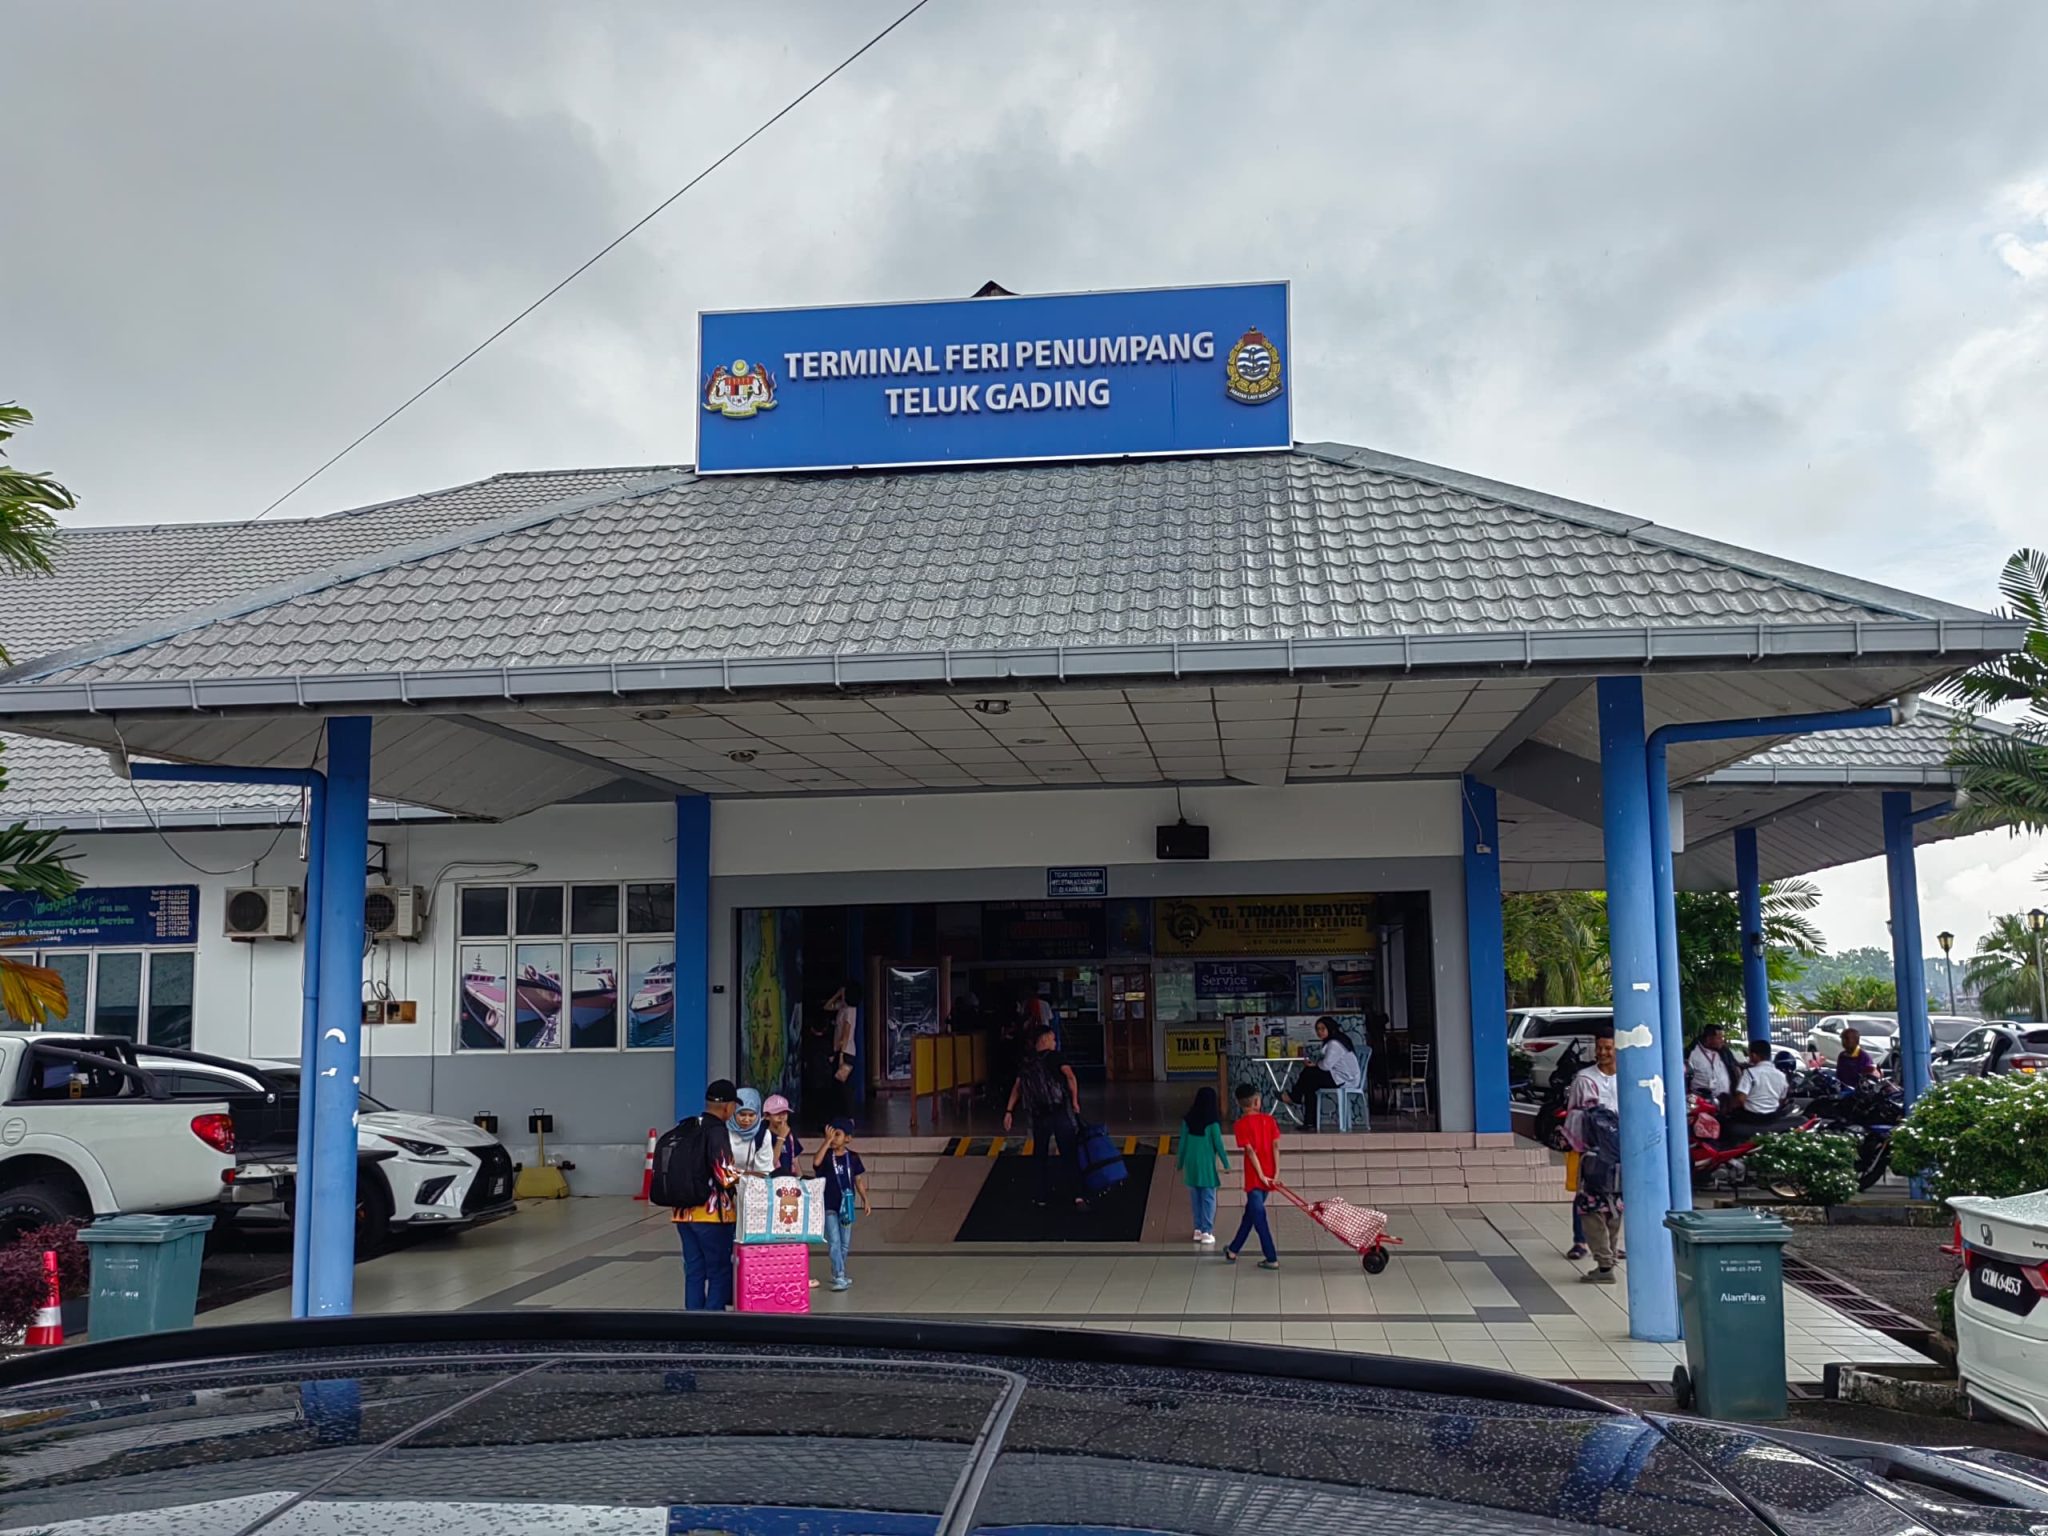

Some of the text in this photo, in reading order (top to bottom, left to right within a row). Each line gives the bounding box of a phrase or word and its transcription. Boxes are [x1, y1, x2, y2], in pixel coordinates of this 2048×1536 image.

[784, 331, 1215, 379] TERMINAL FERI PENUMPANG
[885, 378, 1110, 416] TELUK GADING
[1237, 905, 1299, 917] TIOMAN
[1303, 903, 1369, 916] SERVICE
[99, 917, 135, 925] Services
[1217, 919, 1239, 929] TAXI
[1256, 917, 1319, 928] TRANSPORT
[1320, 916, 1363, 927] SERVICE
[29, 928, 55, 936] Terminal
[1201, 975, 1248, 986] Service
[1176, 1038, 1200, 1052] TAXI
[1203, 1037, 1210, 1051] &
[1997, 1272, 2022, 1297] 6453
[1720, 1292, 1767, 1302] Alamflora
